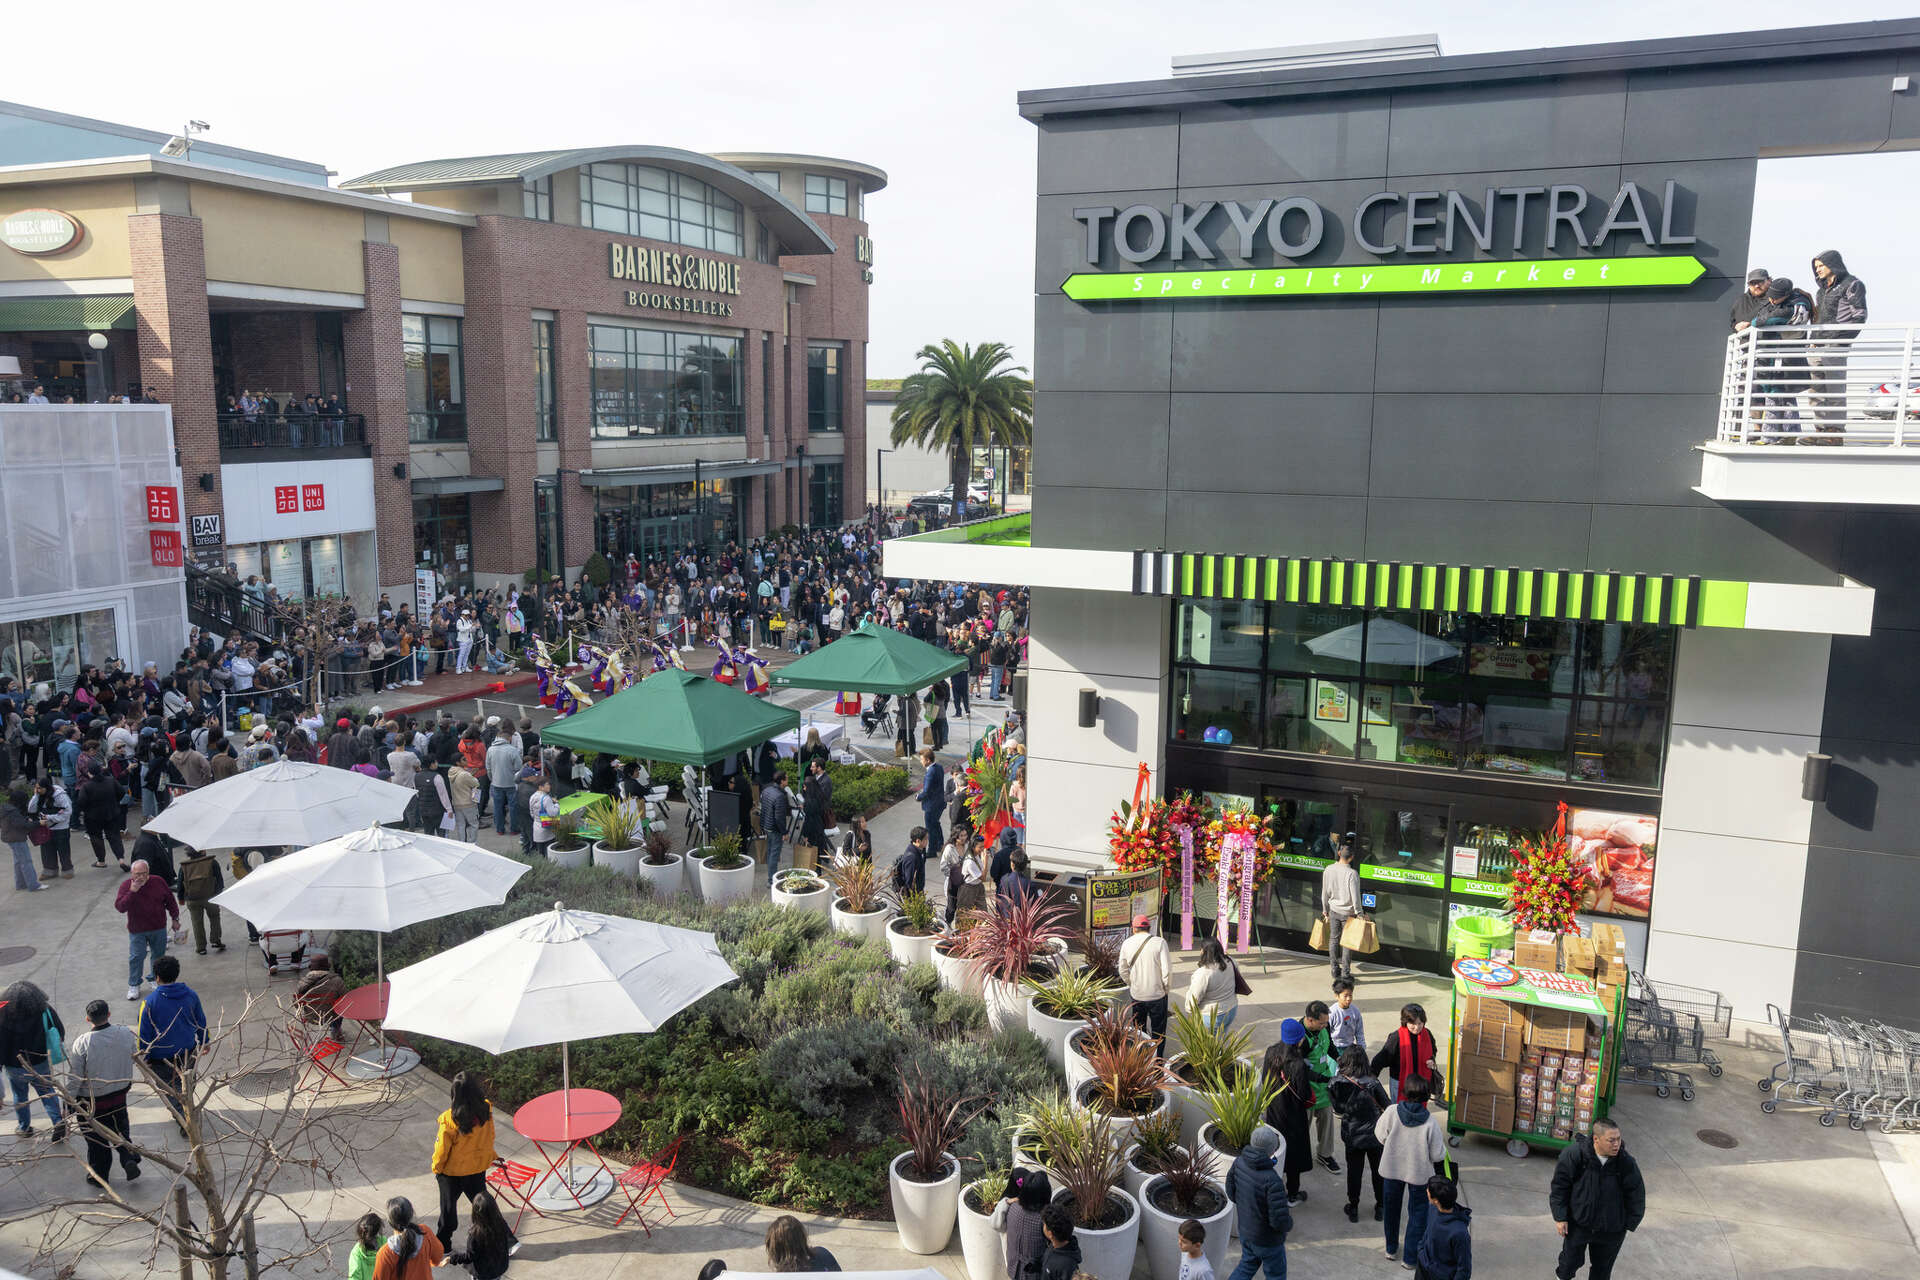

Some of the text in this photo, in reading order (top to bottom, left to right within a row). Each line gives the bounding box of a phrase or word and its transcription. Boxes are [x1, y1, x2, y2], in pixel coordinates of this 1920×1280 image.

[1073, 180, 1697, 264] TOKYO CENTRAL
[1133, 263, 1609, 294] Specialty Market
[629, 290, 733, 317] BOOKSELLERS
[305, 487, 320, 497] UNI
[194, 516, 218, 535] BAY
[154, 535, 172, 548] UNI
[195, 535, 221, 546] break
[155, 549, 175, 562] QLO
[1373, 867, 1433, 881] TOKYO CENTRAL
[1466, 881, 1495, 891] TOKYO
[1518, 969, 1568, 983] SPIN
[1525, 977, 1596, 995] WHEEL
